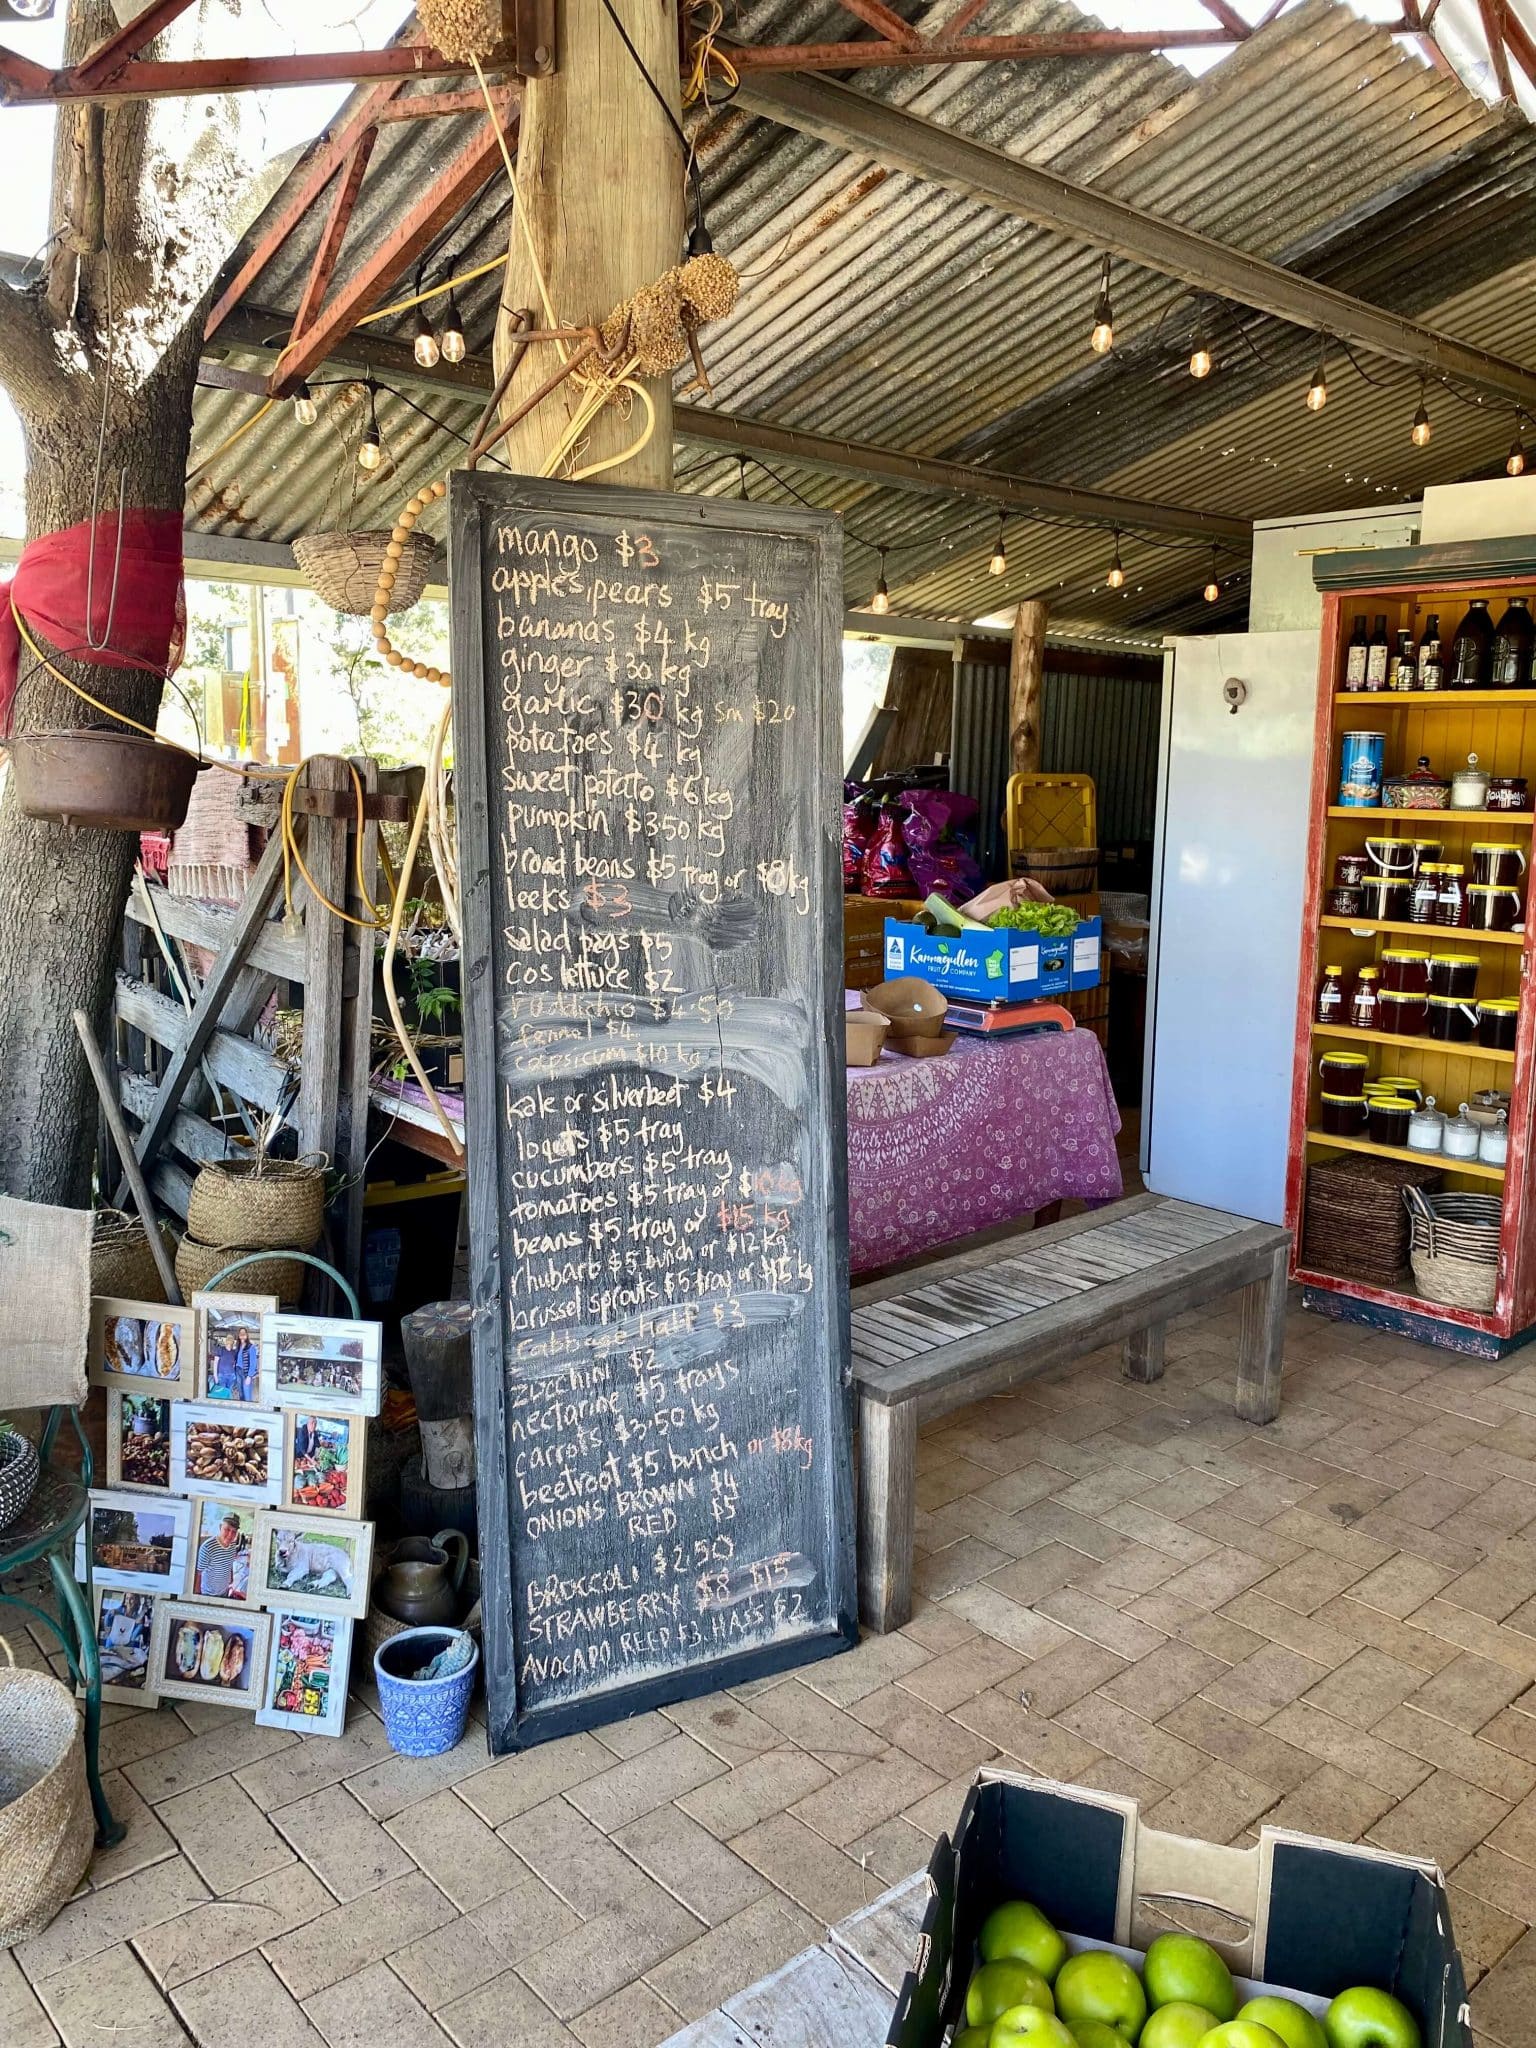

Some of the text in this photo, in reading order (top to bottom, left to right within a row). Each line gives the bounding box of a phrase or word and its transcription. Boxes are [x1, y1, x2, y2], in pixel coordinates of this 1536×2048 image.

[497, 526, 660, 577] mango $3
[497, 599, 711, 668] bananas $4 kg
[698, 577, 740, 615] $5
[743, 579, 788, 639] tray
[501, 647, 691, 697] ginger $30 kg
[502, 690, 596, 734] garlic
[610, 687, 664, 728] $30
[676, 699, 703, 738] kg
[753, 695, 796, 726] $20
[506, 720, 703, 781] potatoes $4 kg
[584, 760, 654, 812] potato
[665, 773, 698, 806] $6
[704, 776, 733, 820] kg
[507, 798, 610, 844] pumpkin
[697, 810, 725, 857] kg
[500, 832, 567, 877] broad
[574, 840, 636, 879] beans
[647, 848, 678, 887] $5
[680, 855, 720, 905] tray
[724, 866, 748, 889] or
[788, 853, 809, 915] kg
[506, 876, 633, 918] leeks $3
[641, 925, 672, 960] $5
[561, 949, 631, 991] lettuce
[644, 966, 687, 996] $2
[636, 1042, 667, 1067] $10
[677, 1042, 701, 1072] kg
[507, 1070, 737, 1128] kale or silverbeet $4
[599, 1120, 629, 1151] $5
[635, 1114, 683, 1151] tray
[511, 1145, 733, 1189] cucumbers $5 tray
[510, 1187, 618, 1223] tomatoes
[628, 1183, 660, 1211] $5
[663, 1178, 707, 1218] tray
[713, 1182, 730, 1199] or
[512, 1228, 583, 1259] beans
[588, 1217, 621, 1249] $5
[628, 1209, 676, 1247] tray
[685, 1216, 704, 1237] or
[764, 1202, 791, 1231] kg
[510, 1252, 601, 1297] rhubarb
[608, 1248, 637, 1276] $5
[645, 1240, 694, 1270] bunch
[702, 1240, 718, 1259] or
[726, 1232, 760, 1261] $12
[510, 1285, 581, 1332] brussel
[589, 1274, 659, 1325] sprouts
[663, 1270, 690, 1300] $5
[693, 1268, 731, 1299] tray
[739, 1262, 754, 1282] or
[712, 1300, 746, 1328] $3
[510, 1348, 664, 1408] zucchini $2
[511, 1359, 740, 1441] nectarine $5 trays
[515, 1425, 602, 1478] carrots
[692, 1396, 720, 1433] kg
[519, 1452, 622, 1511] beetroot
[628, 1449, 660, 1492] $5
[668, 1432, 738, 1472] bunch
[748, 1438, 767, 1454] or
[527, 1468, 739, 1540] ONIONS BROWN $4
[628, 1497, 736, 1541] RED $5
[522, 1584, 682, 1645] STRAWBERRY
[527, 1564, 639, 1616] BROCCOLI
[520, 1640, 611, 1685] AVOCADO
[621, 1628, 670, 1662] REED
[712, 1604, 764, 1638] HASS
